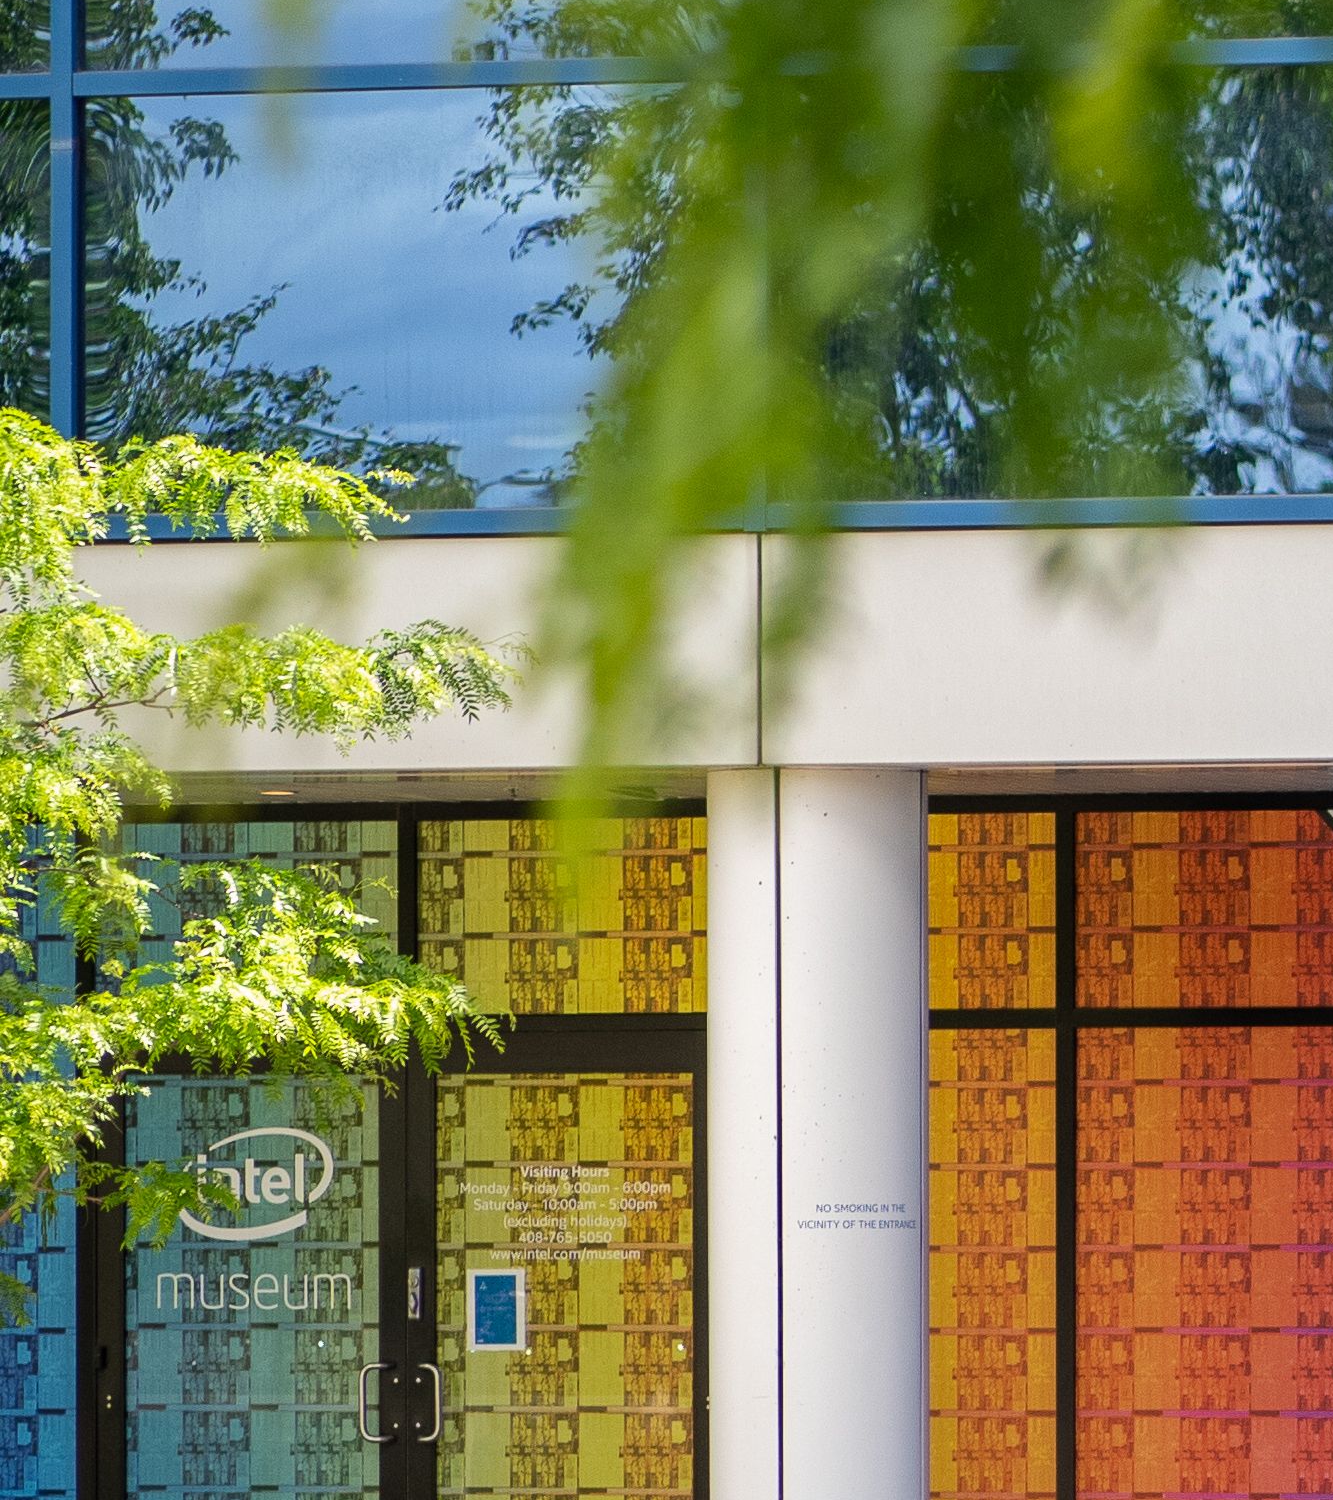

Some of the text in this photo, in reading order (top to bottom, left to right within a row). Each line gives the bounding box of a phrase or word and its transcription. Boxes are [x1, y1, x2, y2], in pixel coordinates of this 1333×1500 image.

[197, 1153, 304, 1204] intel
[520, 1165, 609, 1180] Visiting Hours
[460, 1182, 510, 1197] Monday
[522, 1182, 560, 1197] Friday
[563, 1181, 610, 1195] 9:00am
[623, 1181, 671, 1196] 6:00pm
[473, 1198, 529, 1213] Saturday
[542, 1198, 597, 1211] 10:00am
[609, 1198, 658, 1213] 5:00pm
[815, 1203, 906, 1213] NO SMOKING IN THE
[503, 1213, 627, 1230] (excluding holidays)
[797, 1220, 917, 1229] VICINITY OF THE ENTRANCE
[518, 1231, 613, 1244] 408-765-5050
[490, 1246, 641, 1263] www.intel.com/museum
[156, 1272, 352, 1310] museum
